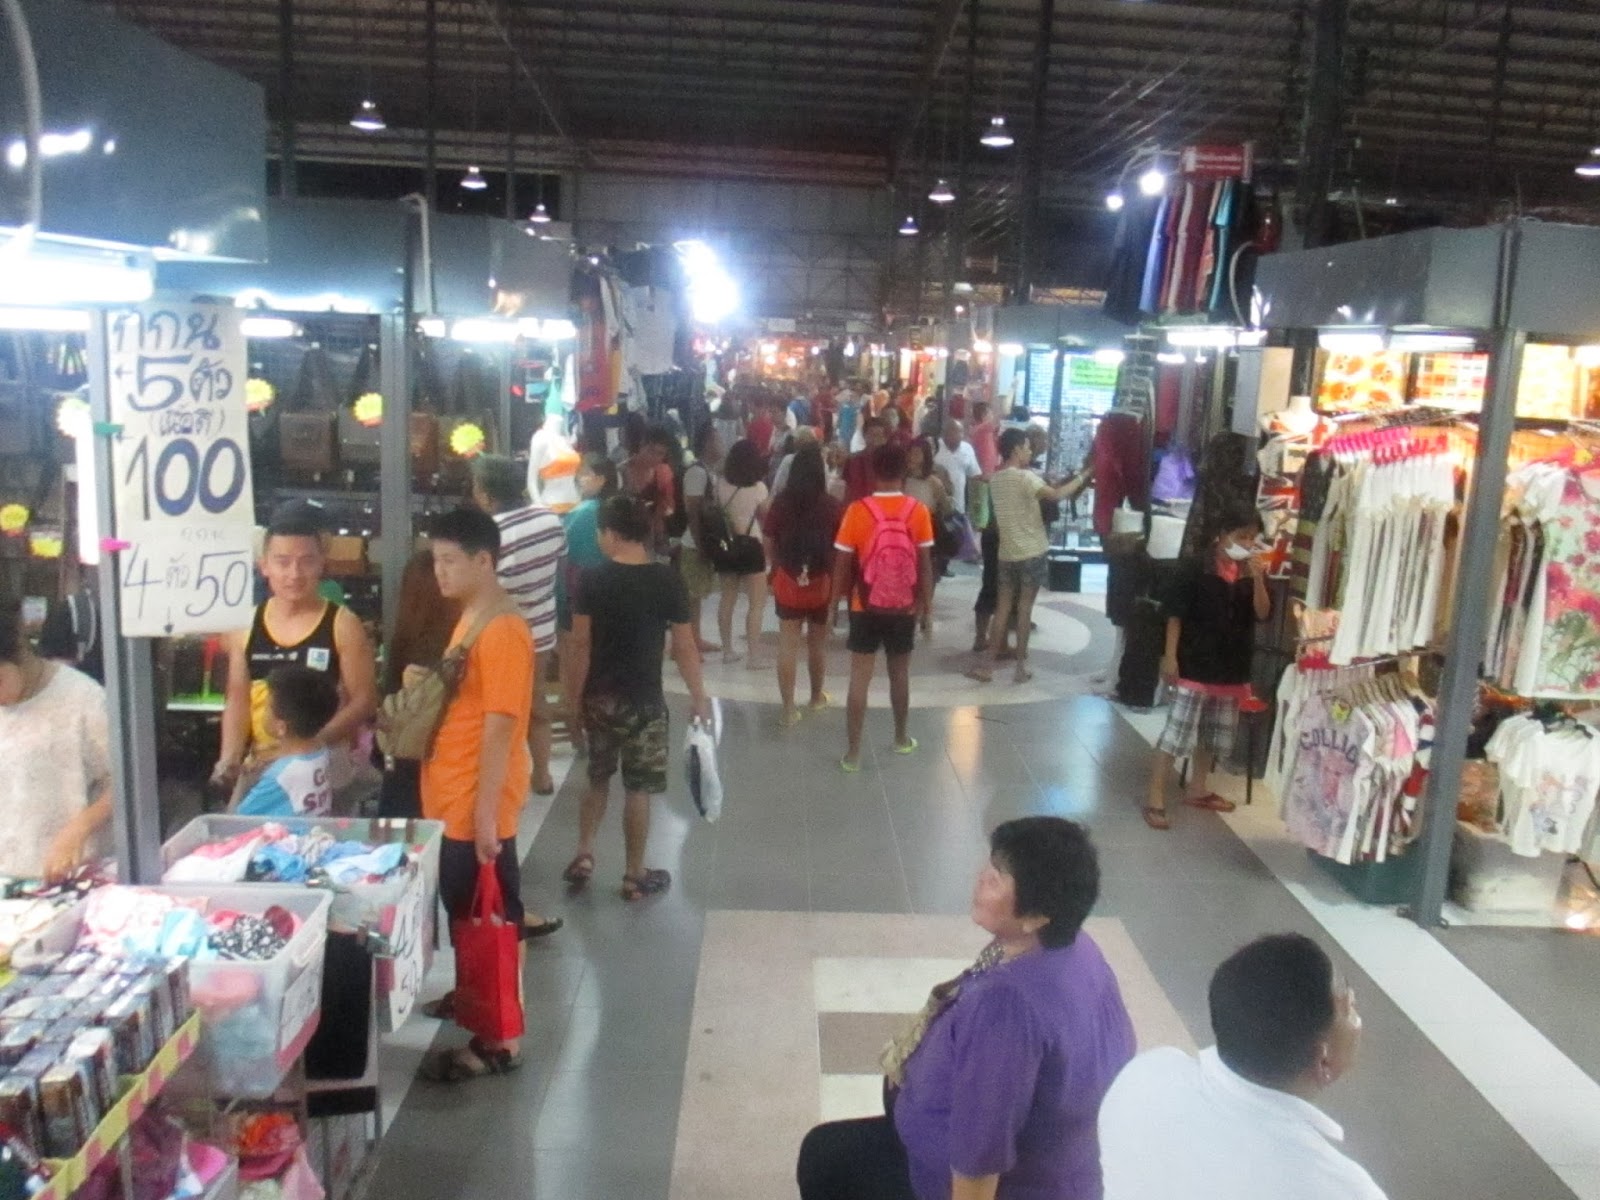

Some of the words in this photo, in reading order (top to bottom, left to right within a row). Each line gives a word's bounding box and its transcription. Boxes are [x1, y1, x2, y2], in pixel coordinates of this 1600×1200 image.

[128, 354, 194, 412] 5
[125, 435, 246, 521] 100
[123, 543, 163, 620] 4
[185, 549, 249, 617] 50
